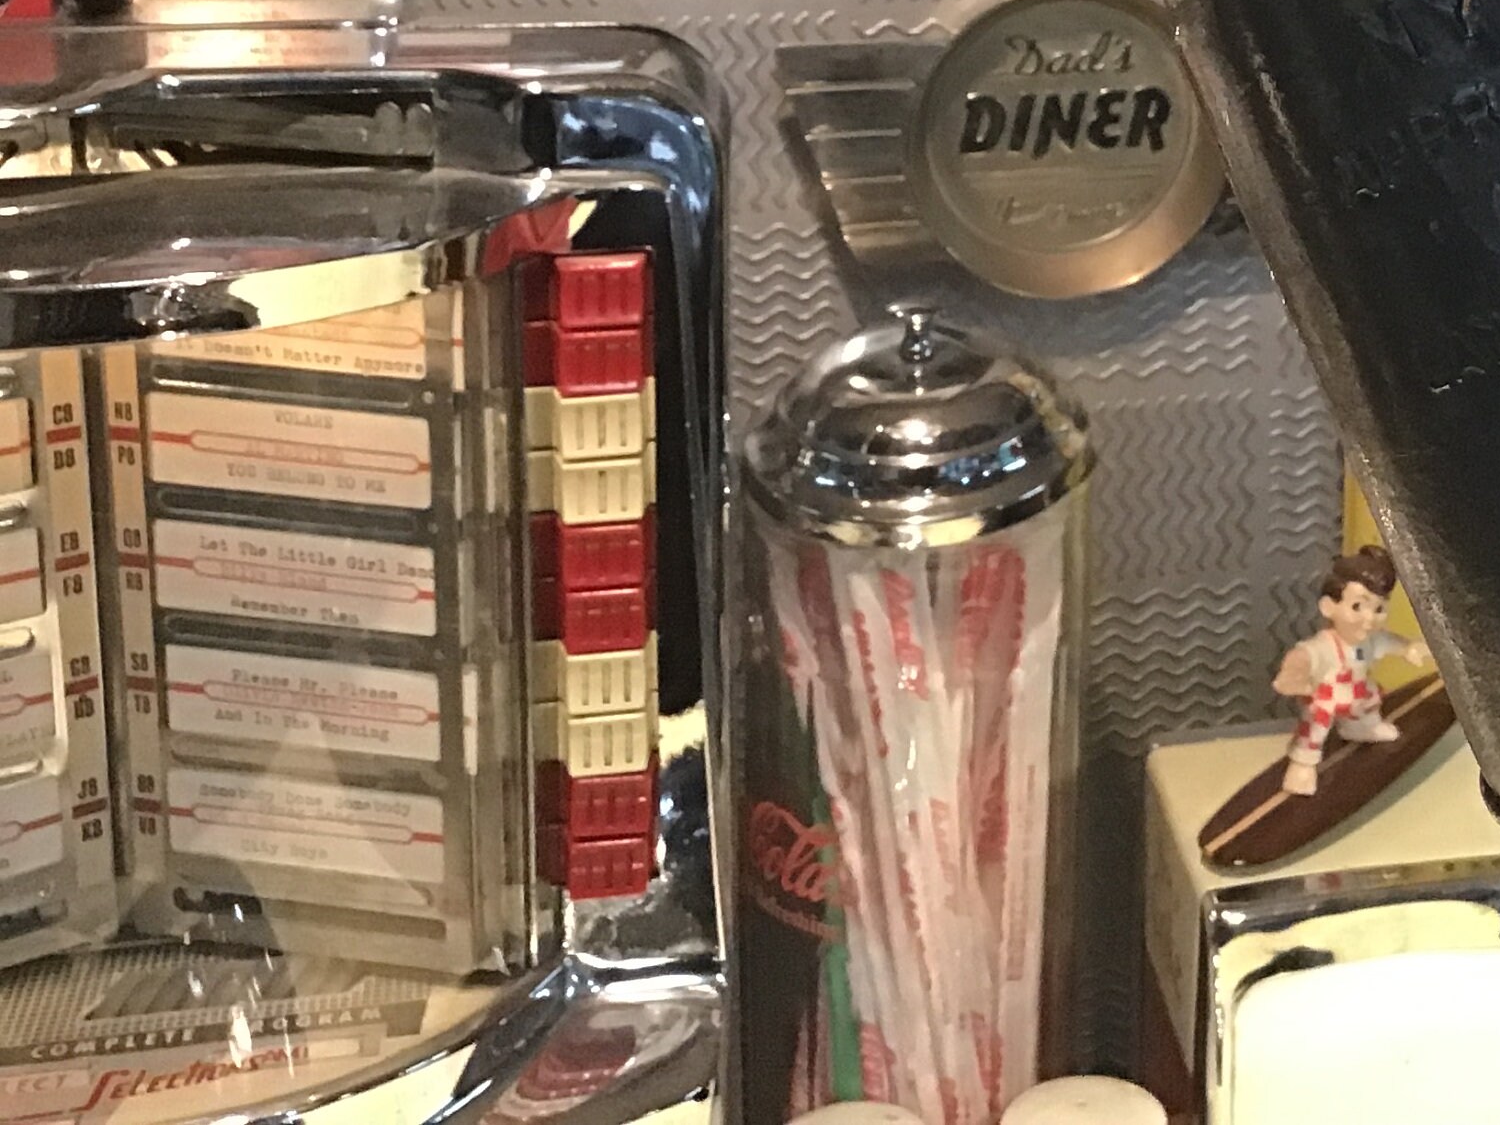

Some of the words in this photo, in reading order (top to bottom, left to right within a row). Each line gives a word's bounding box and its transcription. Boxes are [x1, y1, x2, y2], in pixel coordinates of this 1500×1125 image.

[1004, 29, 1137, 76] Dad's
[958, 85, 1172, 161] DINER
[283, 347, 343, 367] Matter
[200, 535, 227, 552] Let
[239, 539, 267, 557] The
[278, 546, 336, 567] Little
[346, 555, 387, 574] Girl
[30, 1027, 195, 1059] COMPLETE
